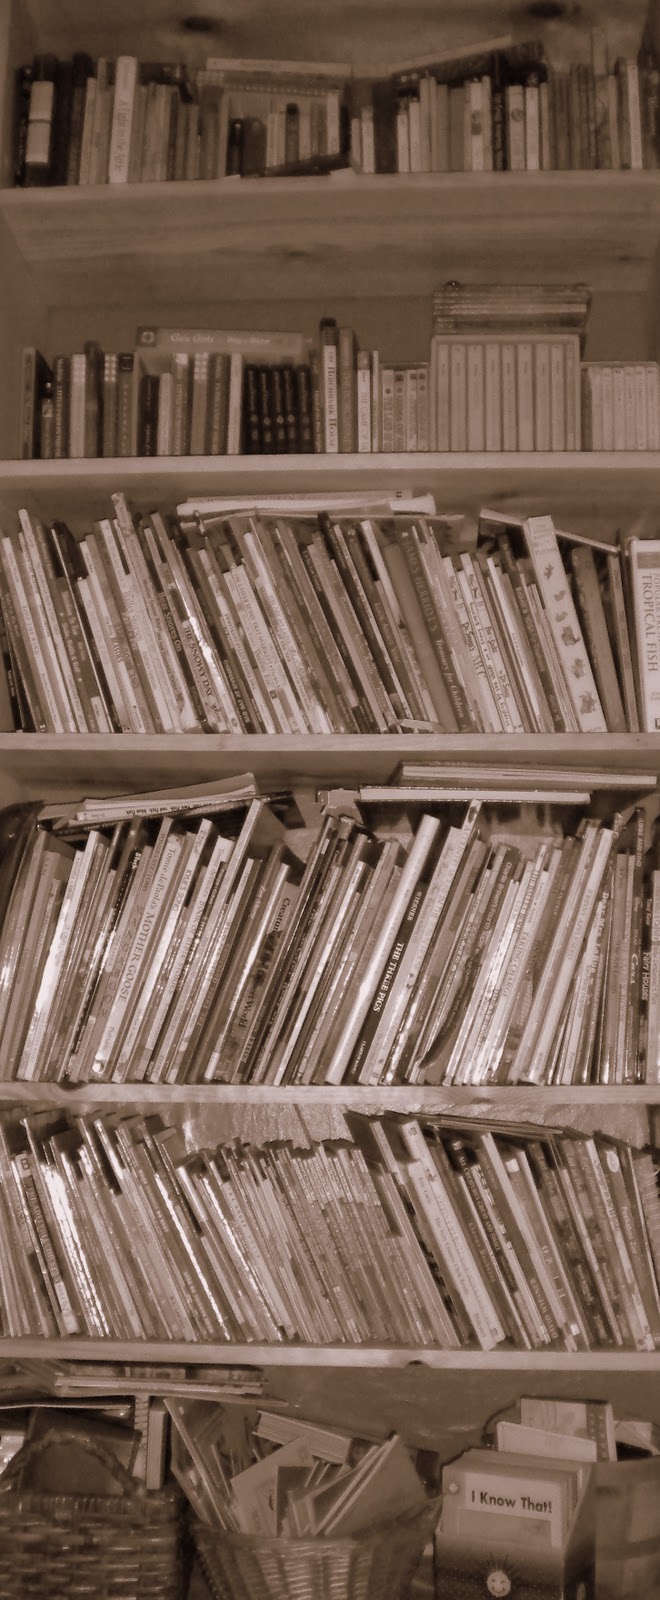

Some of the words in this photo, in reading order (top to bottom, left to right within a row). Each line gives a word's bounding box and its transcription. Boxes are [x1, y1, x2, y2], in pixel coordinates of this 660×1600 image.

[157, 591, 170, 610] Bear
[642, 574, 656, 638] TROPICAL
[163, 611, 179, 639] Snores
[172, 638, 183, 652] On
[434, 637, 451, 670] Treasury
[647, 642, 658, 672] FISH
[182, 626, 194, 642] THE
[188, 642, 206, 677] SNOWY
[201, 679, 214, 698] DAY
[444, 670, 455, 683] for
[448, 684, 466, 718] Children
[159, 846, 177, 874] Tomie
[498, 860, 513, 883] Charlie
[147, 872, 168, 911] dePaola's
[405, 889, 423, 921] WIESNER
[598, 891, 610, 914] Dear
[192, 899, 206, 922] BOOK
[482, 907, 497, 929] Fourth
[130, 911, 156, 963] MOTHER
[390, 940, 405, 960] THE
[512, 930, 528, 962] TAKING
[629, 953, 639, 985] Cars
[641, 951, 650, 970] Fairy
[117, 964, 138, 1003] GOOSE
[379, 960, 398, 991] THREE
[640, 972, 650, 1000] Houses
[236, 999, 254, 1028] World
[371, 991, 387, 1013] PIGS
[620, 1205, 634, 1240] Peekaboo
[628, 1240, 638, 1254] Zoo
[472, 1490, 475, 1502] I
[480, 1492, 516, 1508] Know
[520, 1496, 552, 1514] That!
